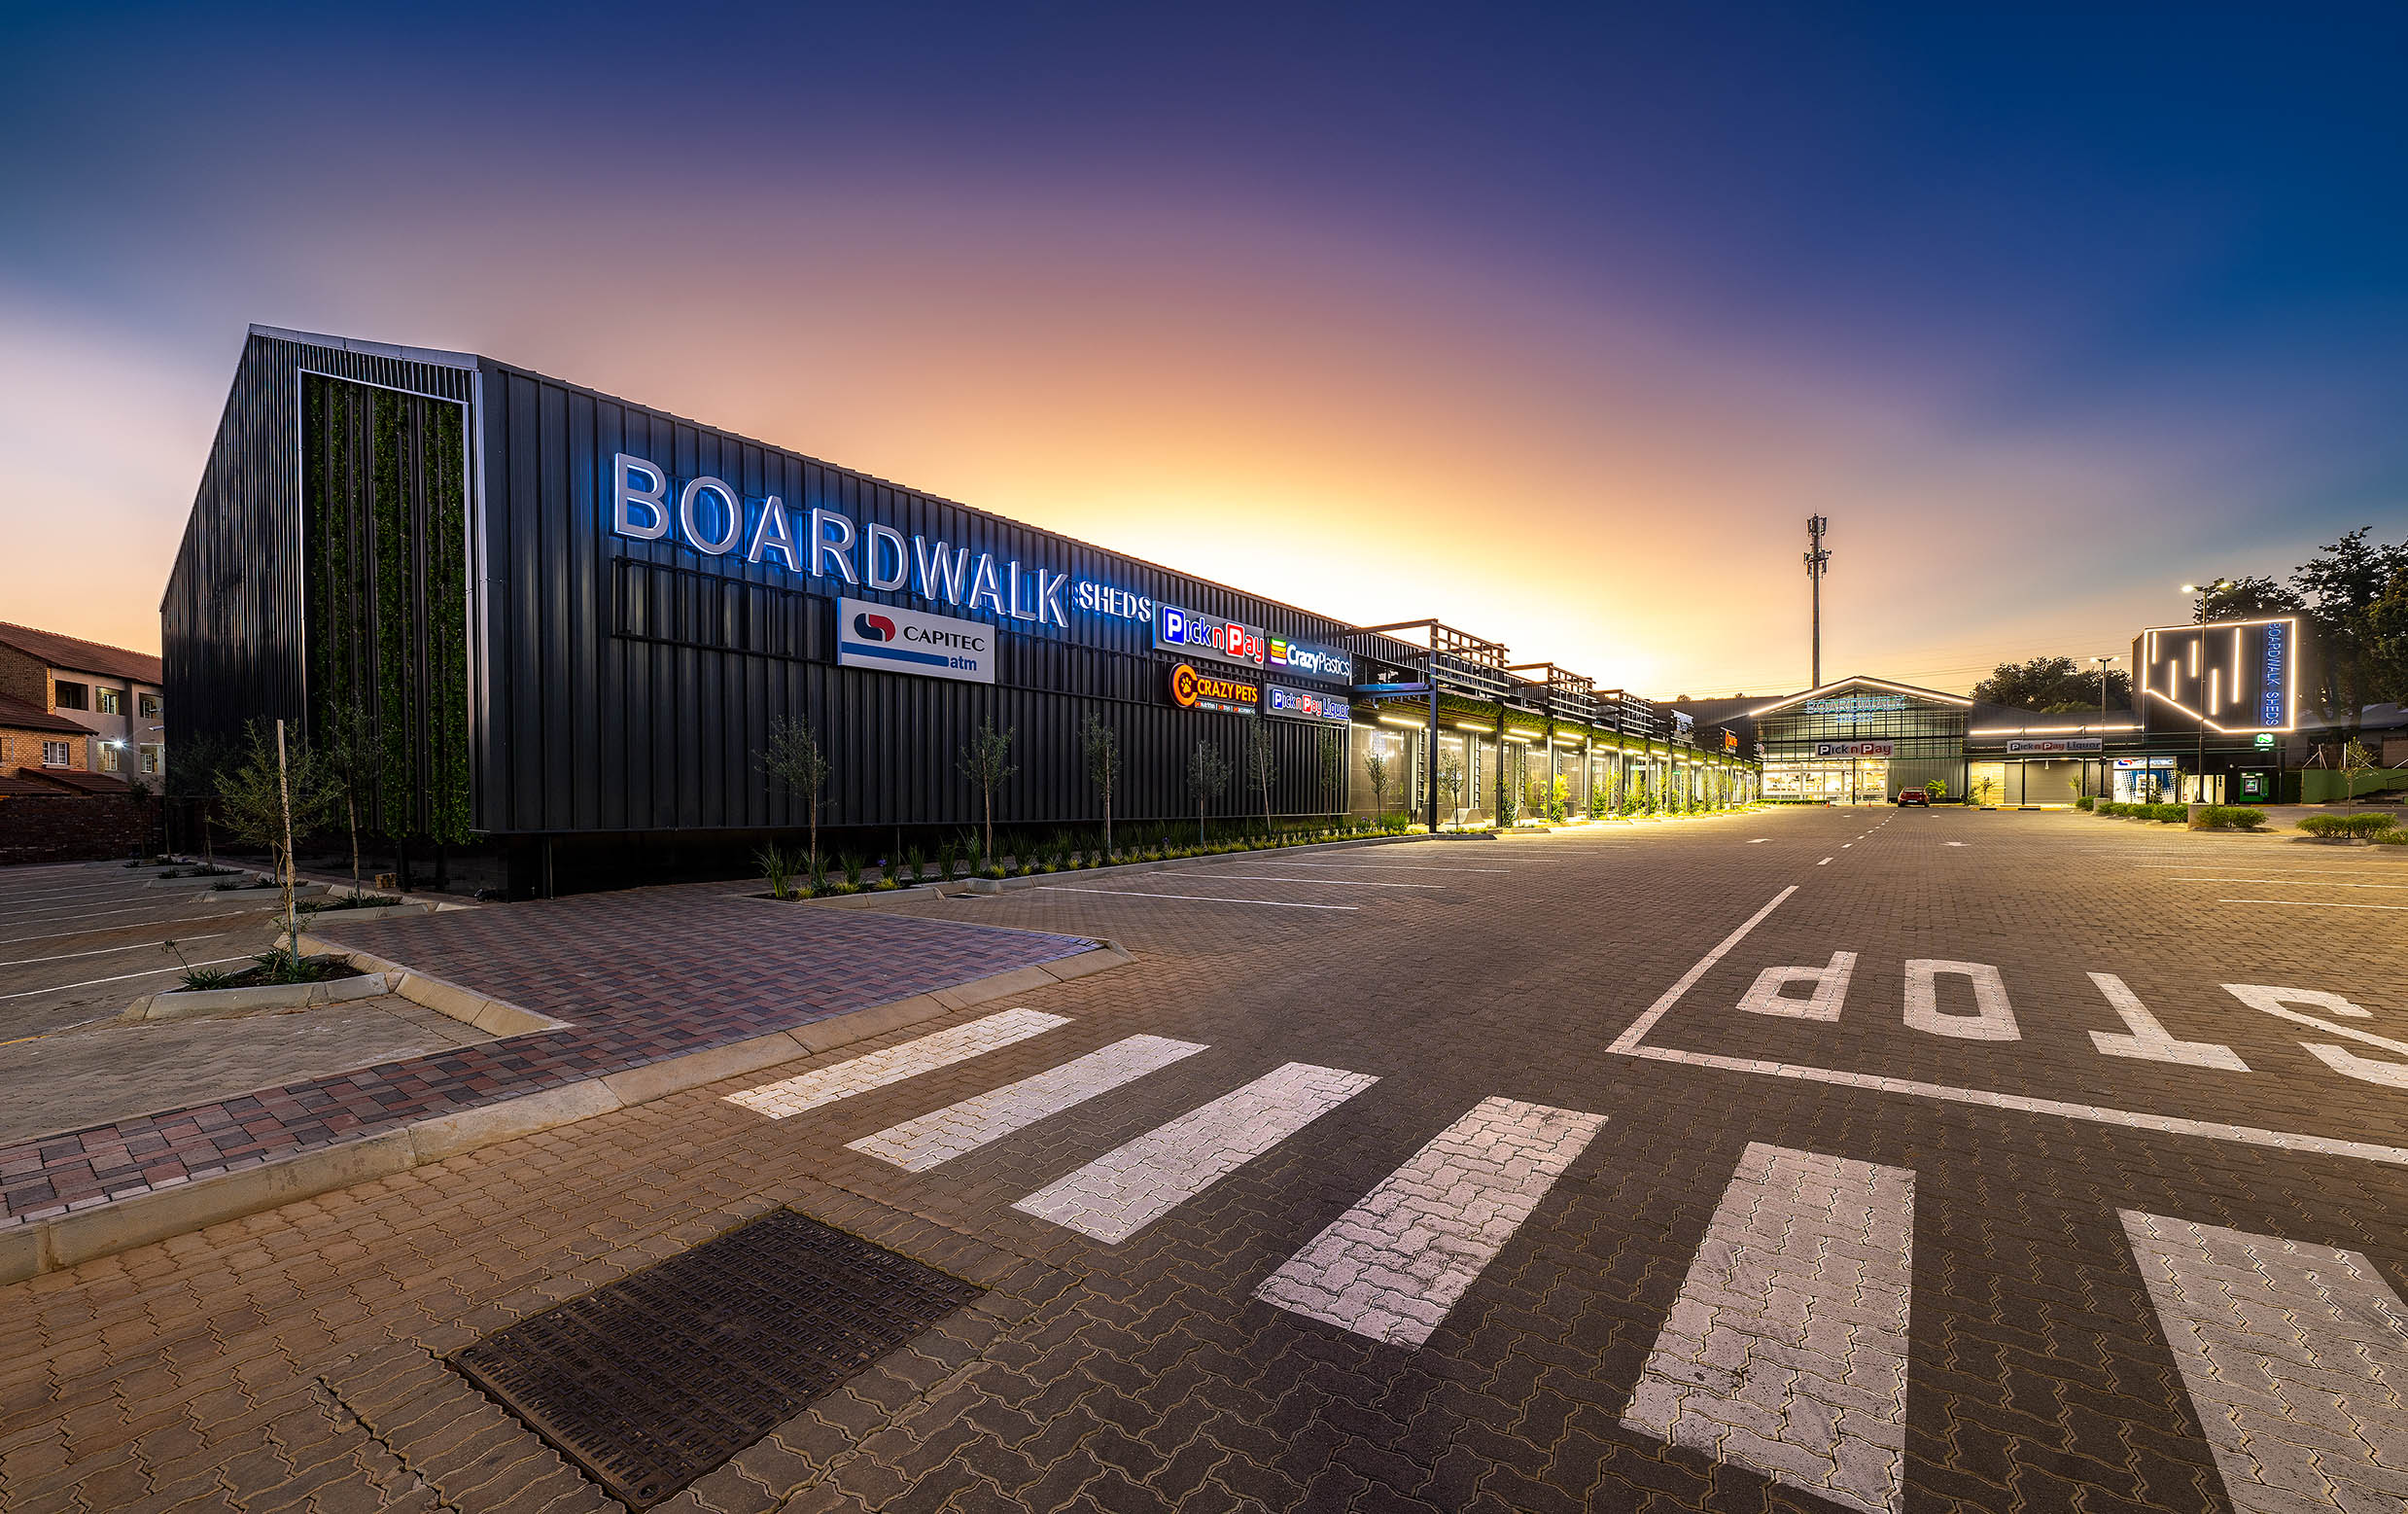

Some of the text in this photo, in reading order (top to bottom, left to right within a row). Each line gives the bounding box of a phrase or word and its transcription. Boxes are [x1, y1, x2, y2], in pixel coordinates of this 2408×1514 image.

[614, 452, 1069, 628] BOARDWALK
[1079, 581, 1152, 622] SHEDS
[903, 625, 986, 652] CAPITEC
[950, 655, 978, 671] atm
[1197, 679, 1258, 703] CRAZY PETS
[1323, 697, 1350, 720] Liquor
[1805, 695, 1906, 714] BOARDWALK
[2265, 691, 2280, 726] SHEDS
[2067, 741, 2101, 750] Liquor
[1735, 950, 2408, 1089] STOP
